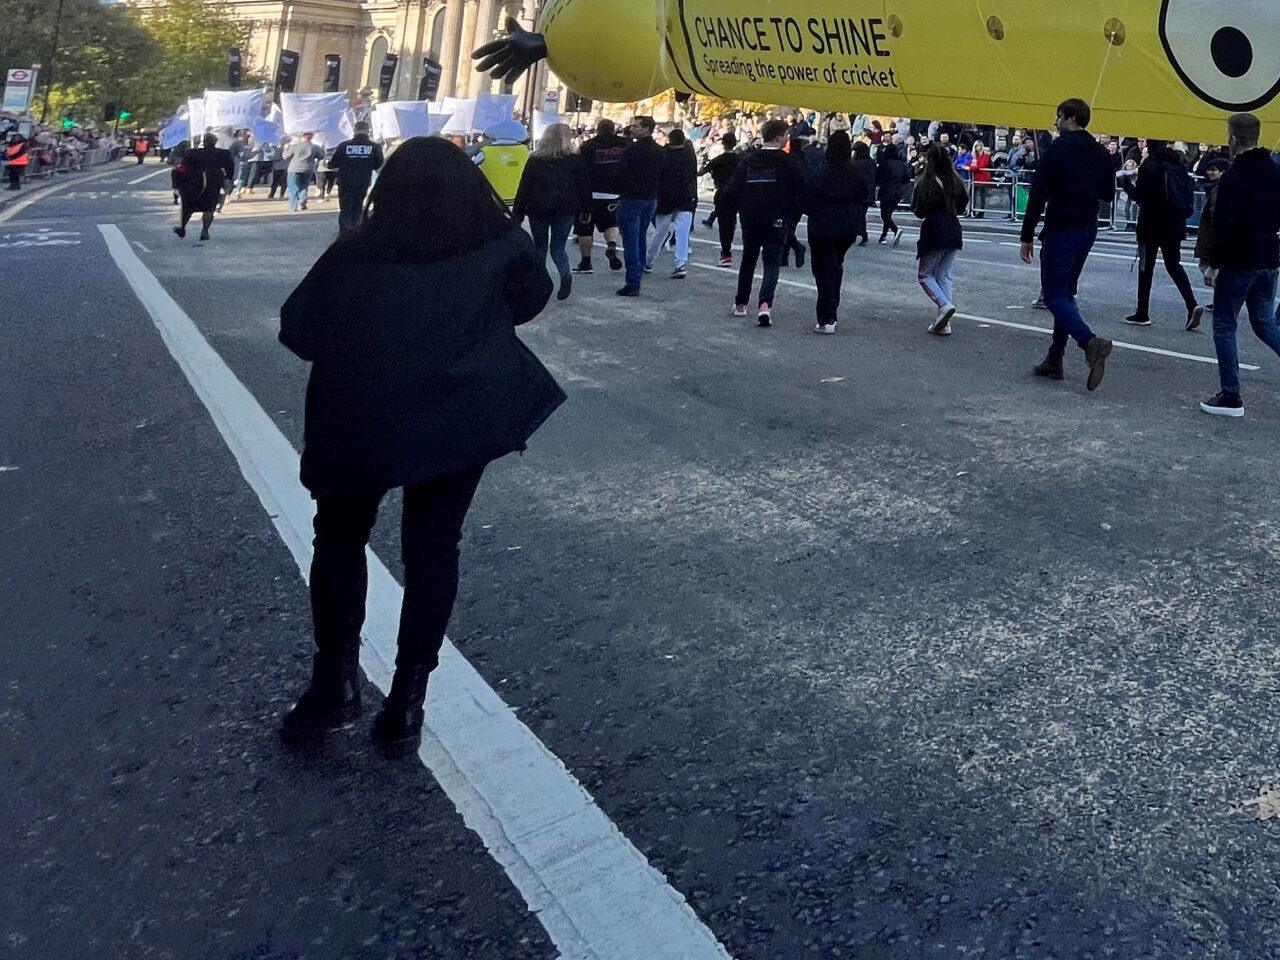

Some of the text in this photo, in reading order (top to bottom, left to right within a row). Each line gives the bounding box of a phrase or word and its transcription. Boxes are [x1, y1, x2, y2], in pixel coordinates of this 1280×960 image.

[694, 16, 891, 57] CHANCE TO SHINE
[702, 54, 898, 88] Spreading the power of cricket
[346, 145, 373, 155] CREW
